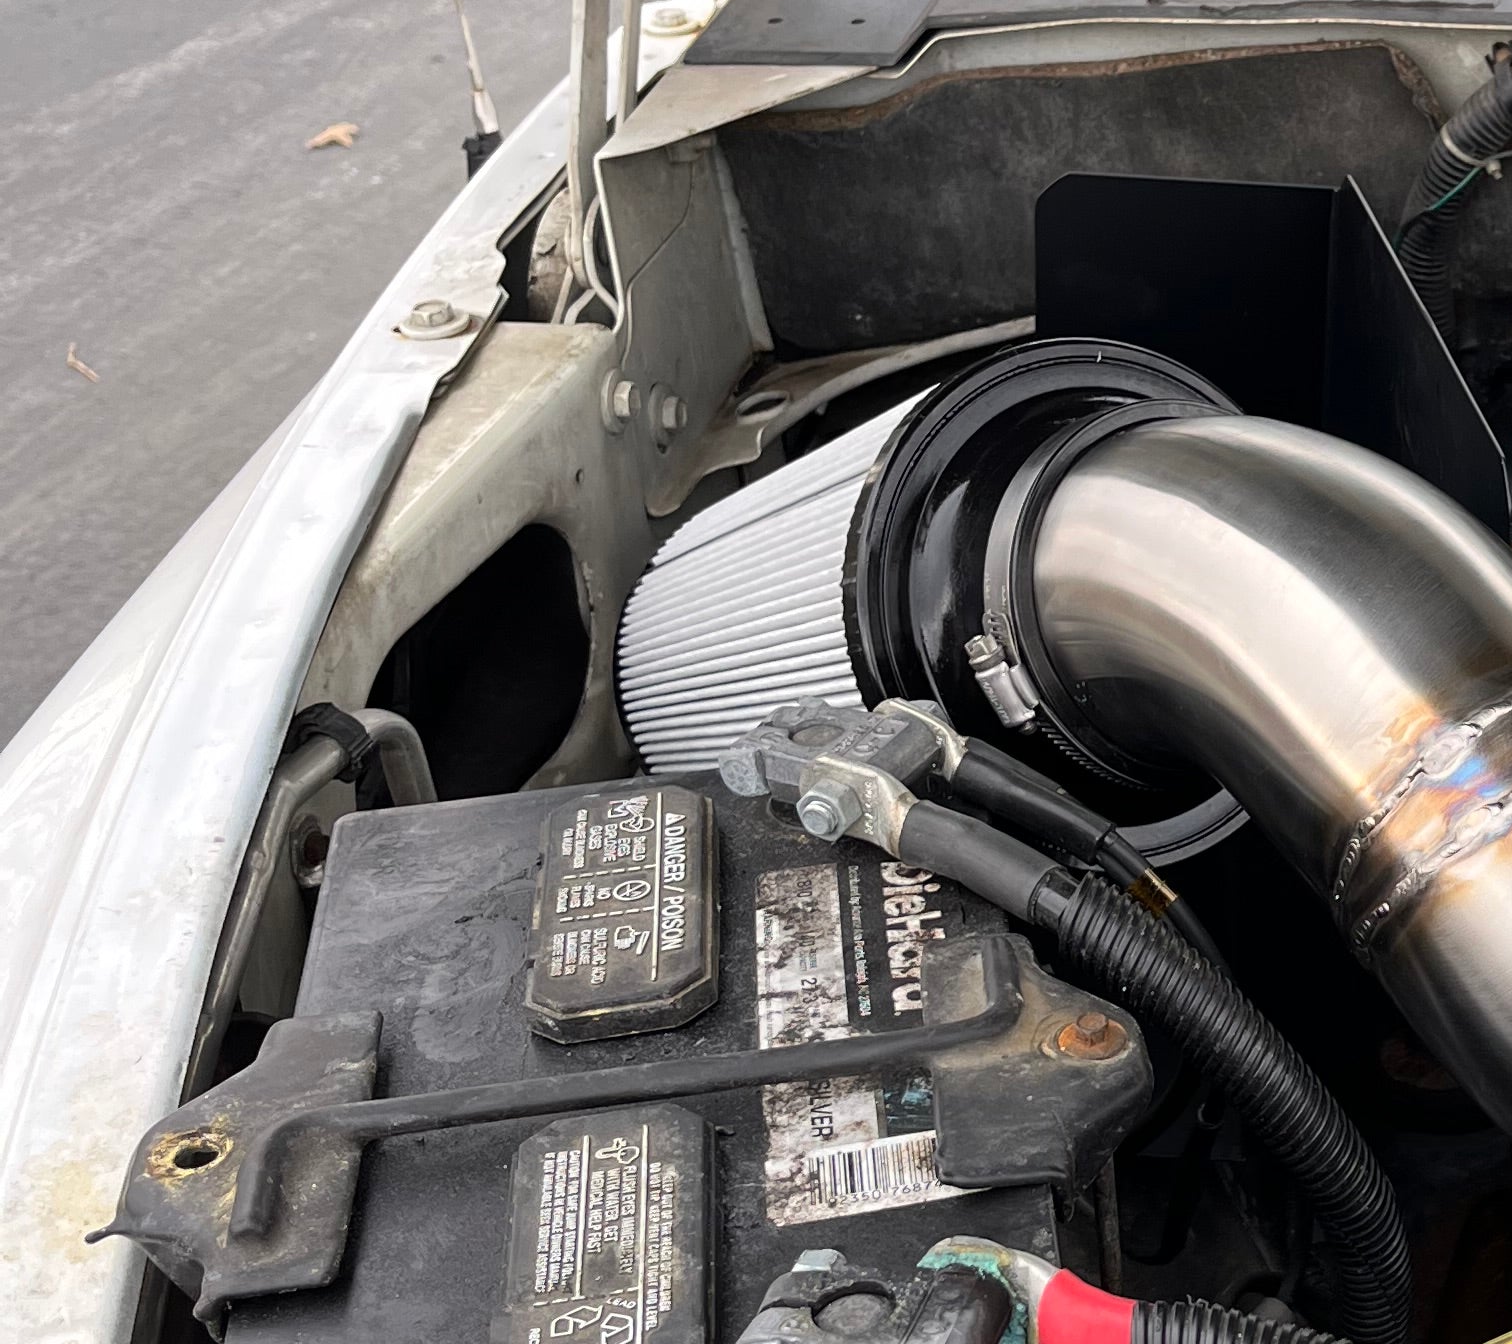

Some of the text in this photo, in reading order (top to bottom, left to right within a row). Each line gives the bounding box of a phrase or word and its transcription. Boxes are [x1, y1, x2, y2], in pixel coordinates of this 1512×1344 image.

[663, 826, 685, 882] DANGER
[661, 896, 684, 951] POISON
[807, 1079, 834, 1142] SILVER
[606, 1168, 620, 1190] WITH
[622, 1165, 637, 1193] FLUSH
[587, 1171, 604, 1254] MEDICAL HELP FAST
[622, 1194, 636, 1215] EYES
[604, 1225, 618, 1242] GET
[645, 1306, 657, 1331] LEVEL
